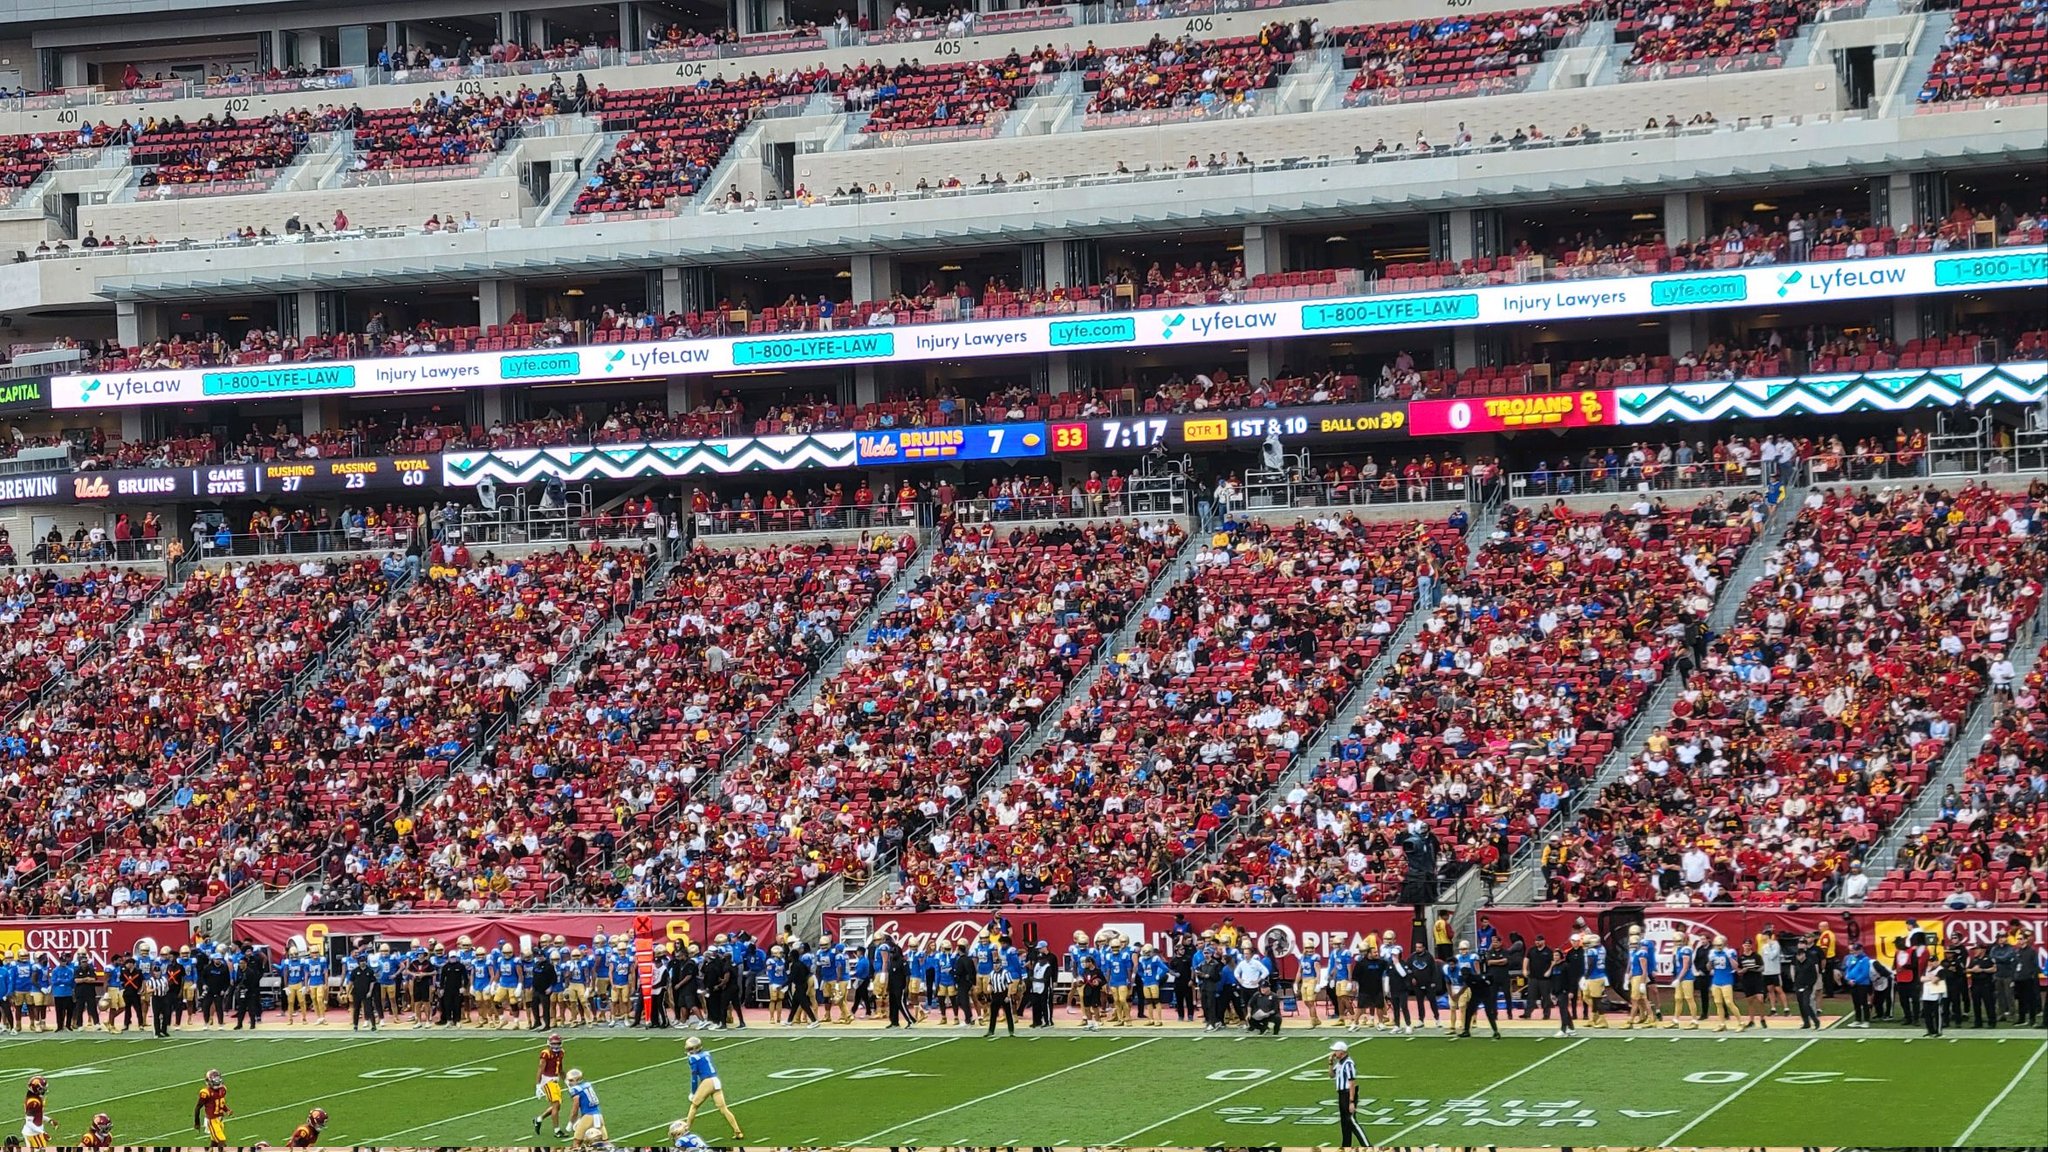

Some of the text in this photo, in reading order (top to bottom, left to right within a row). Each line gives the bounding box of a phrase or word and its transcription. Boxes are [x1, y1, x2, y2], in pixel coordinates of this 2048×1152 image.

[1185, 18, 1213, 32] 406
[934, 41, 961, 55] 405
[676, 63, 702, 78] 404
[455, 81, 481, 95] 403
[224, 98, 249, 112] 402
[57, 110, 78, 123] 401
[1662, 281, 1737, 299] Lyfe.com
[1504, 292, 1626, 313] Injury Lawyers
[1319, 300, 1461, 323] 1-800-LYFE-LAW
[916, 330, 1027, 350] Injury Lawyers
[1058, 323, 1126, 341] Lyfe.com
[749, 338, 877, 358] 1-800-LYFE-LAW
[376, 364, 480, 383] Injury Lawyers
[509, 358, 571, 375] Lyfe.com
[217, 370, 340, 390] 1-800-LYFE-LAW
[0, 383, 40, 403] CAPITAL
[1449, 402, 1472, 429] 0
[1484, 393, 1573, 416] TROJANS
[1187, 423, 1223, 436] QTR 1
[1231, 417, 1308, 437] 1ST & 10
[1320, 411, 1405, 433] BALL ON 39
[900, 429, 964, 447] BRUINS
[988, 429, 1005, 454] 7
[1056, 428, 1083, 447] 33
[1103, 419, 1168, 448] 7:17
[267, 464, 315, 477] RUSHING
[331, 462, 377, 474] PASSING
[394, 459, 430, 471] TOTAL
[208, 469, 244, 480] GAME
[345, 473, 365, 488] 23
[402, 470, 424, 485] 60
[118, 477, 176, 493] BRUINS
[207, 481, 246, 494] STATS
[281, 476, 302, 491] 37
[26, 928, 112, 950] CREDIT
[1946, 918, 2048, 945] CREI
